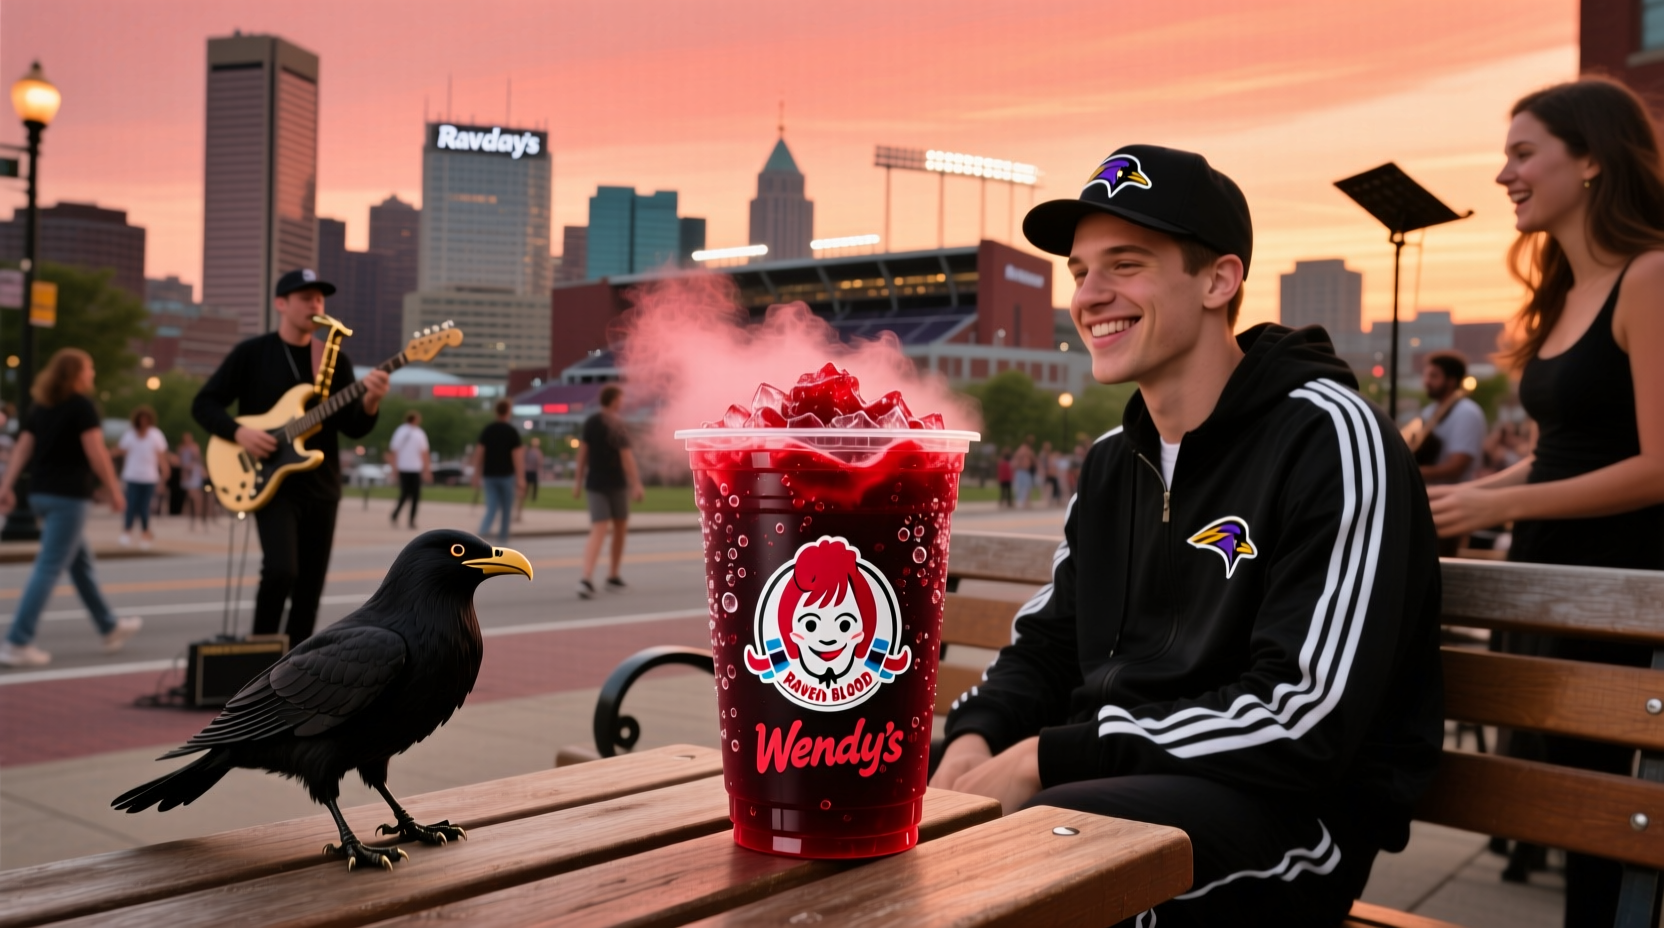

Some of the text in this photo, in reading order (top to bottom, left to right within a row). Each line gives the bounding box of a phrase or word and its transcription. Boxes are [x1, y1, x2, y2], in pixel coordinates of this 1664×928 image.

[437, 124, 540, 160] Ravday's
[832, 671, 873, 702] BLOOD
[755, 717, 904, 778] Wendy's
